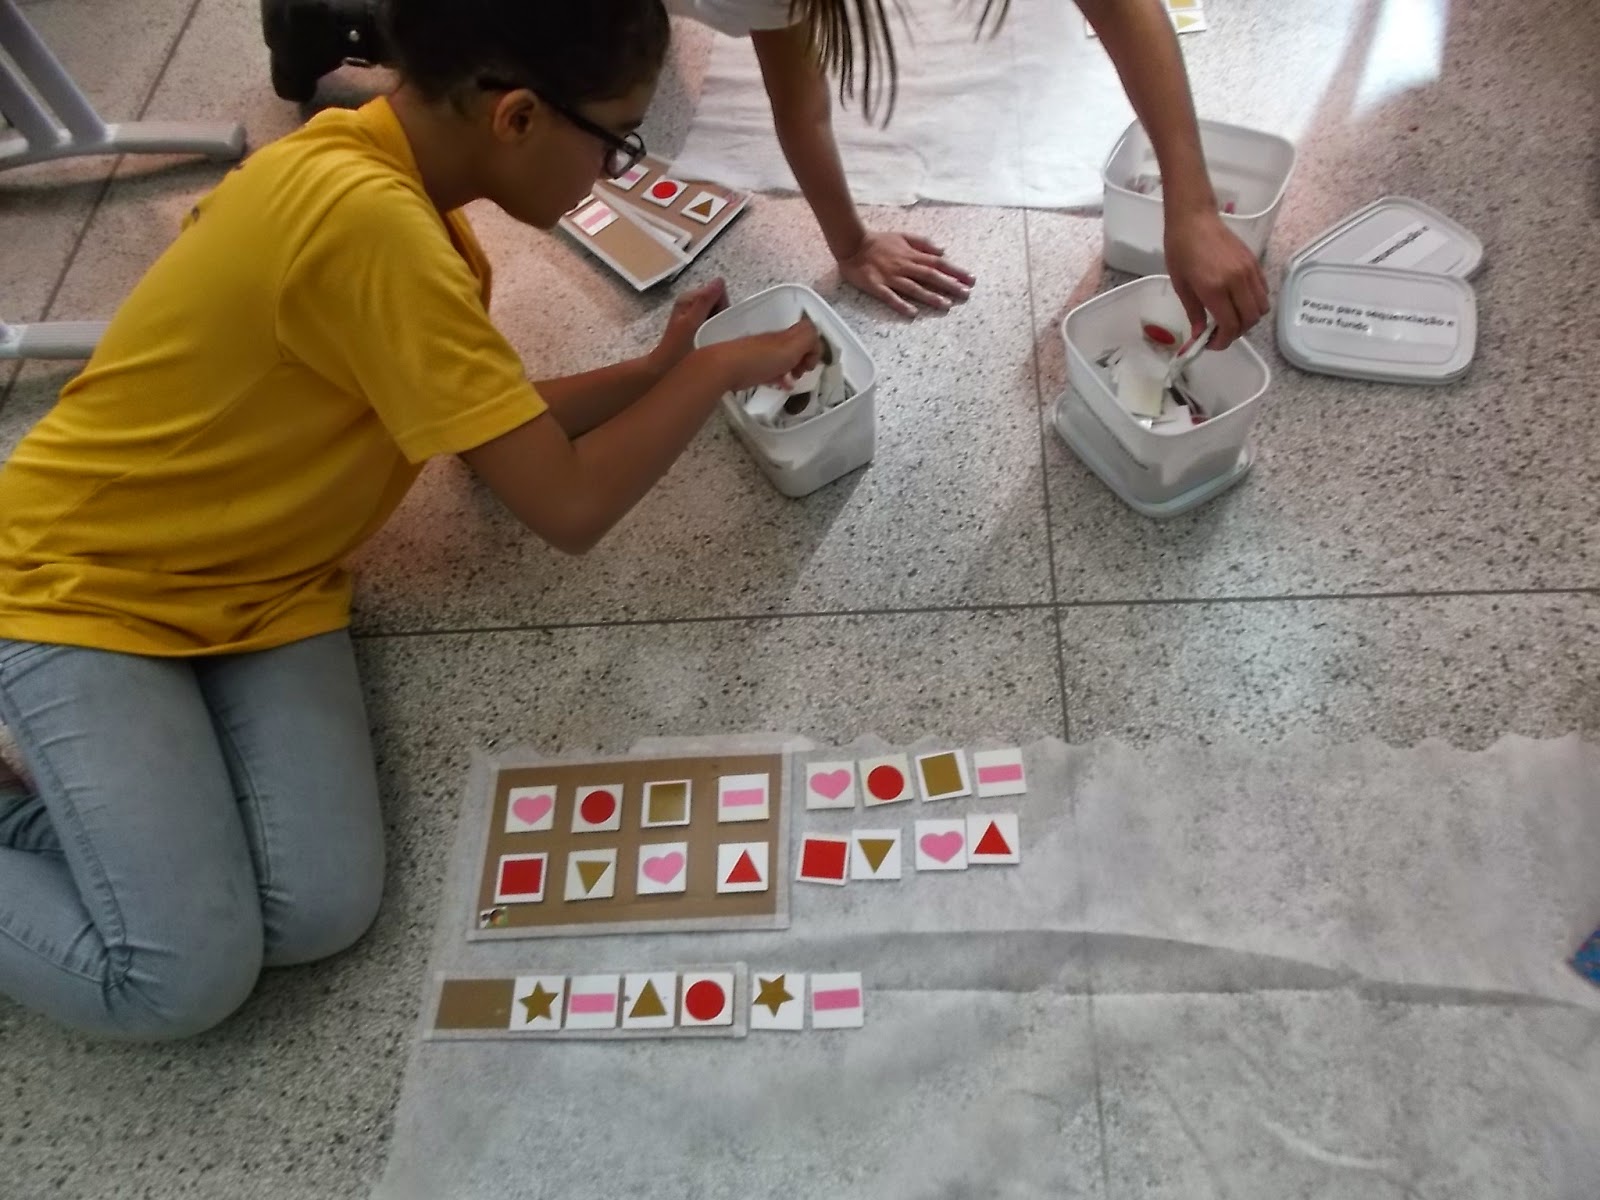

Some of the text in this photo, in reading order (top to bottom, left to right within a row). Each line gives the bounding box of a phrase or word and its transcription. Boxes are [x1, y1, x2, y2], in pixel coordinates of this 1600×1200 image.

[1301, 313, 1369, 331] figura fundo
[1302, 299, 1334, 311] Peças
[1336, 306, 1363, 316] para
[1365, 310, 1445, 326] sequenciação
